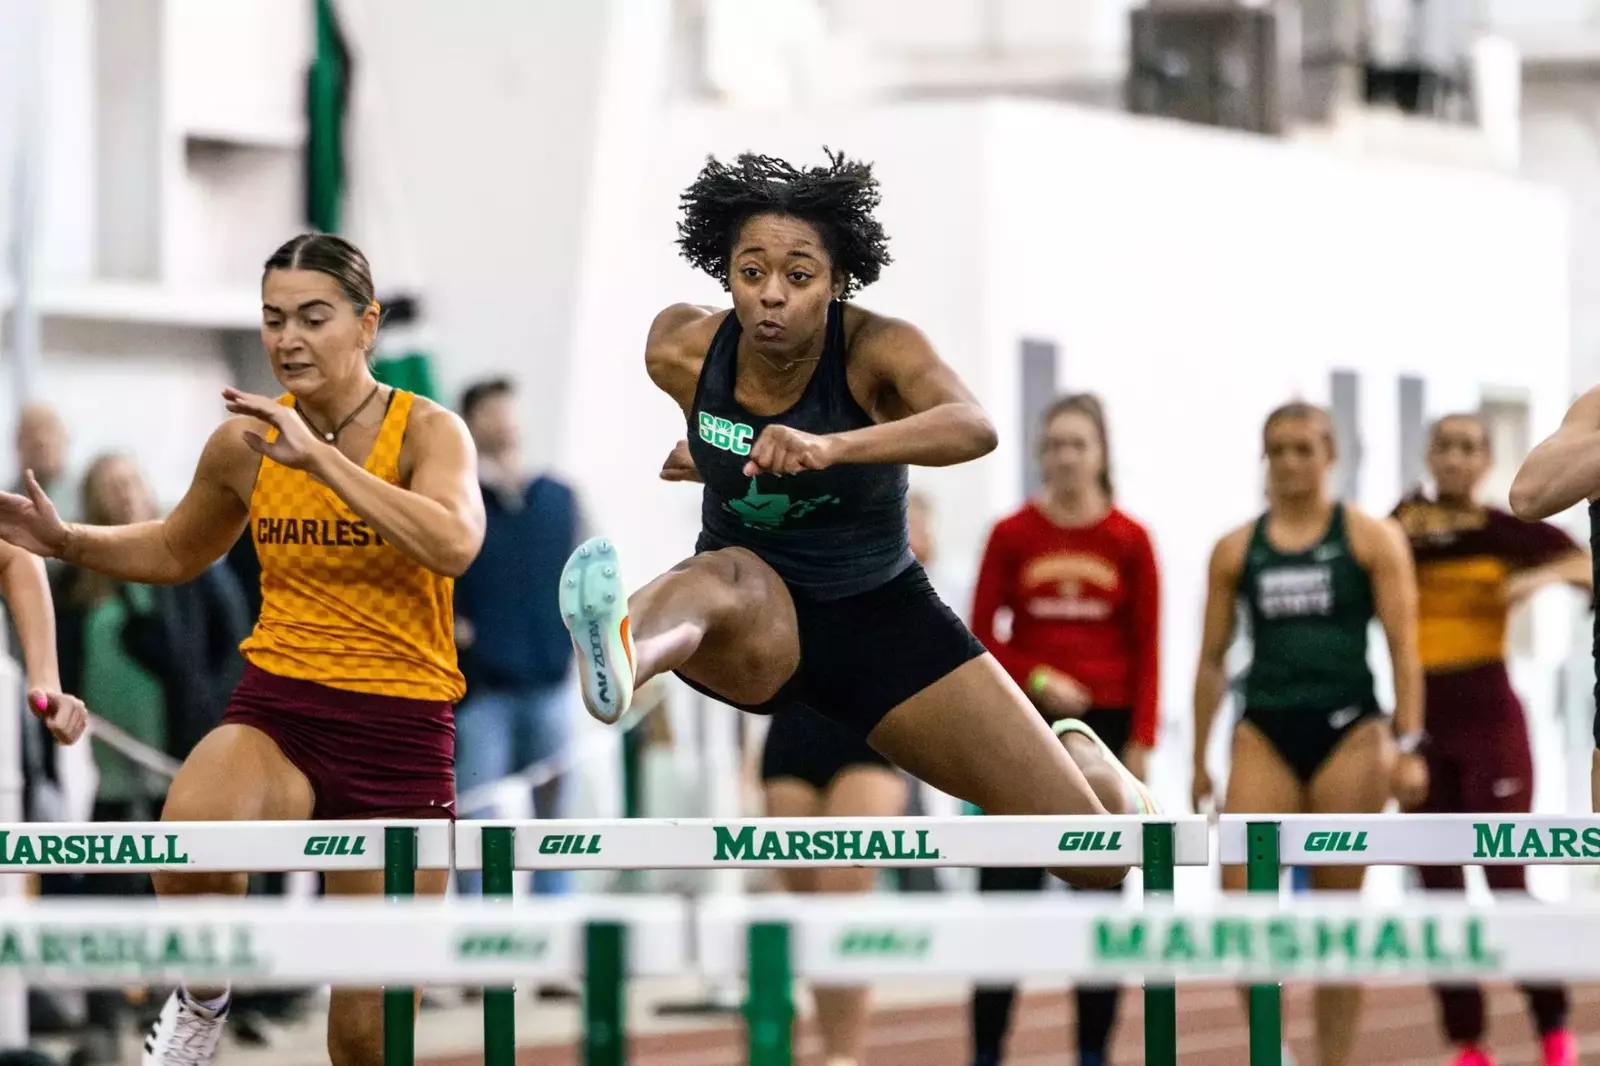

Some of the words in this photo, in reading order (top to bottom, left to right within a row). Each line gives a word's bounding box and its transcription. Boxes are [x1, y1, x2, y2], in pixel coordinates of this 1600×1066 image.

[699, 411, 753, 456] SBC
[257, 517, 386, 547] CHARLES
[0, 831, 188, 865] ARSHALL
[304, 835, 366, 856] GILL
[538, 834, 602, 855] GILL
[713, 825, 940, 860] MARSHALL
[1058, 831, 1122, 852] GILL
[1304, 831, 1368, 852] GILL
[1091, 916, 1503, 967] MARSHALL
